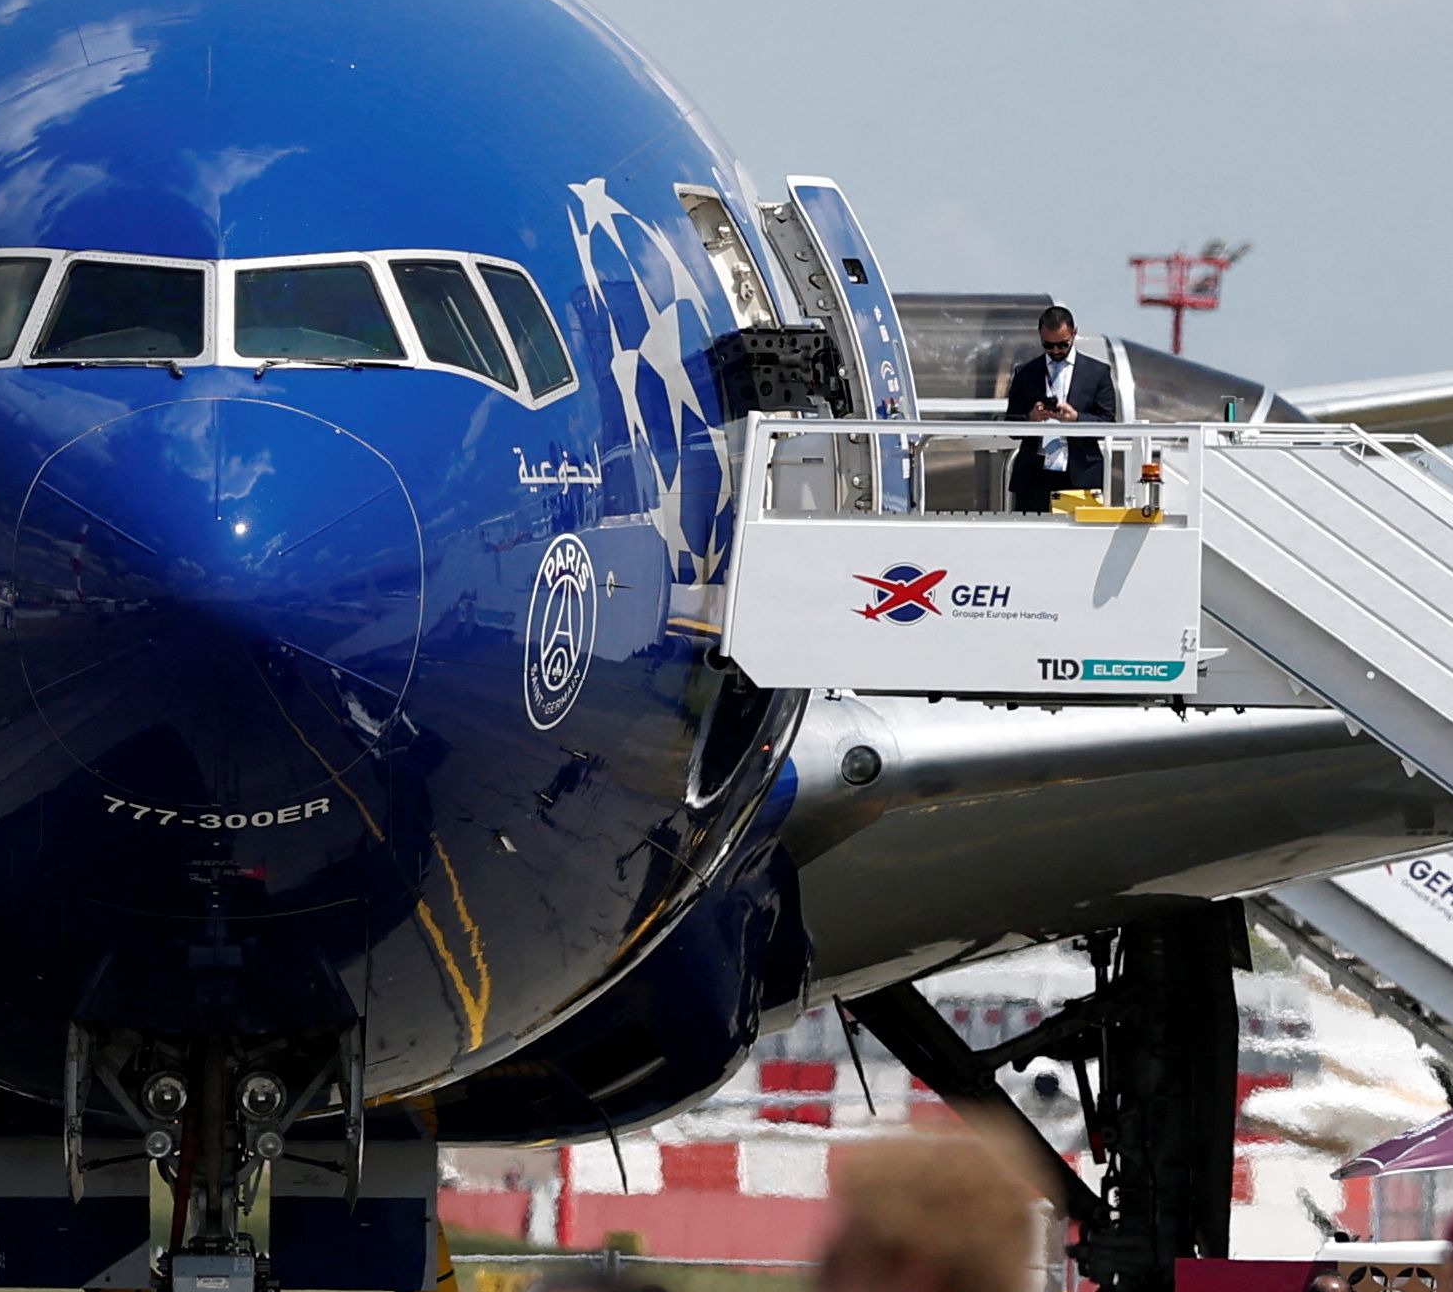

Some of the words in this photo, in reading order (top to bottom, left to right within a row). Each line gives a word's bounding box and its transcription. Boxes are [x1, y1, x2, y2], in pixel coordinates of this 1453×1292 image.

[543, 543, 590, 593] PARIS
[951, 585, 1011, 608] GEH
[952, 610, 985, 619] Groupe
[986, 610, 1018, 620] Europe
[1020, 611, 1059, 621] Handling
[1037, 658, 1080, 680] TLD
[1093, 663, 1169, 677] ELECTRIC
[103, 794, 331, 829] 777-300ER
